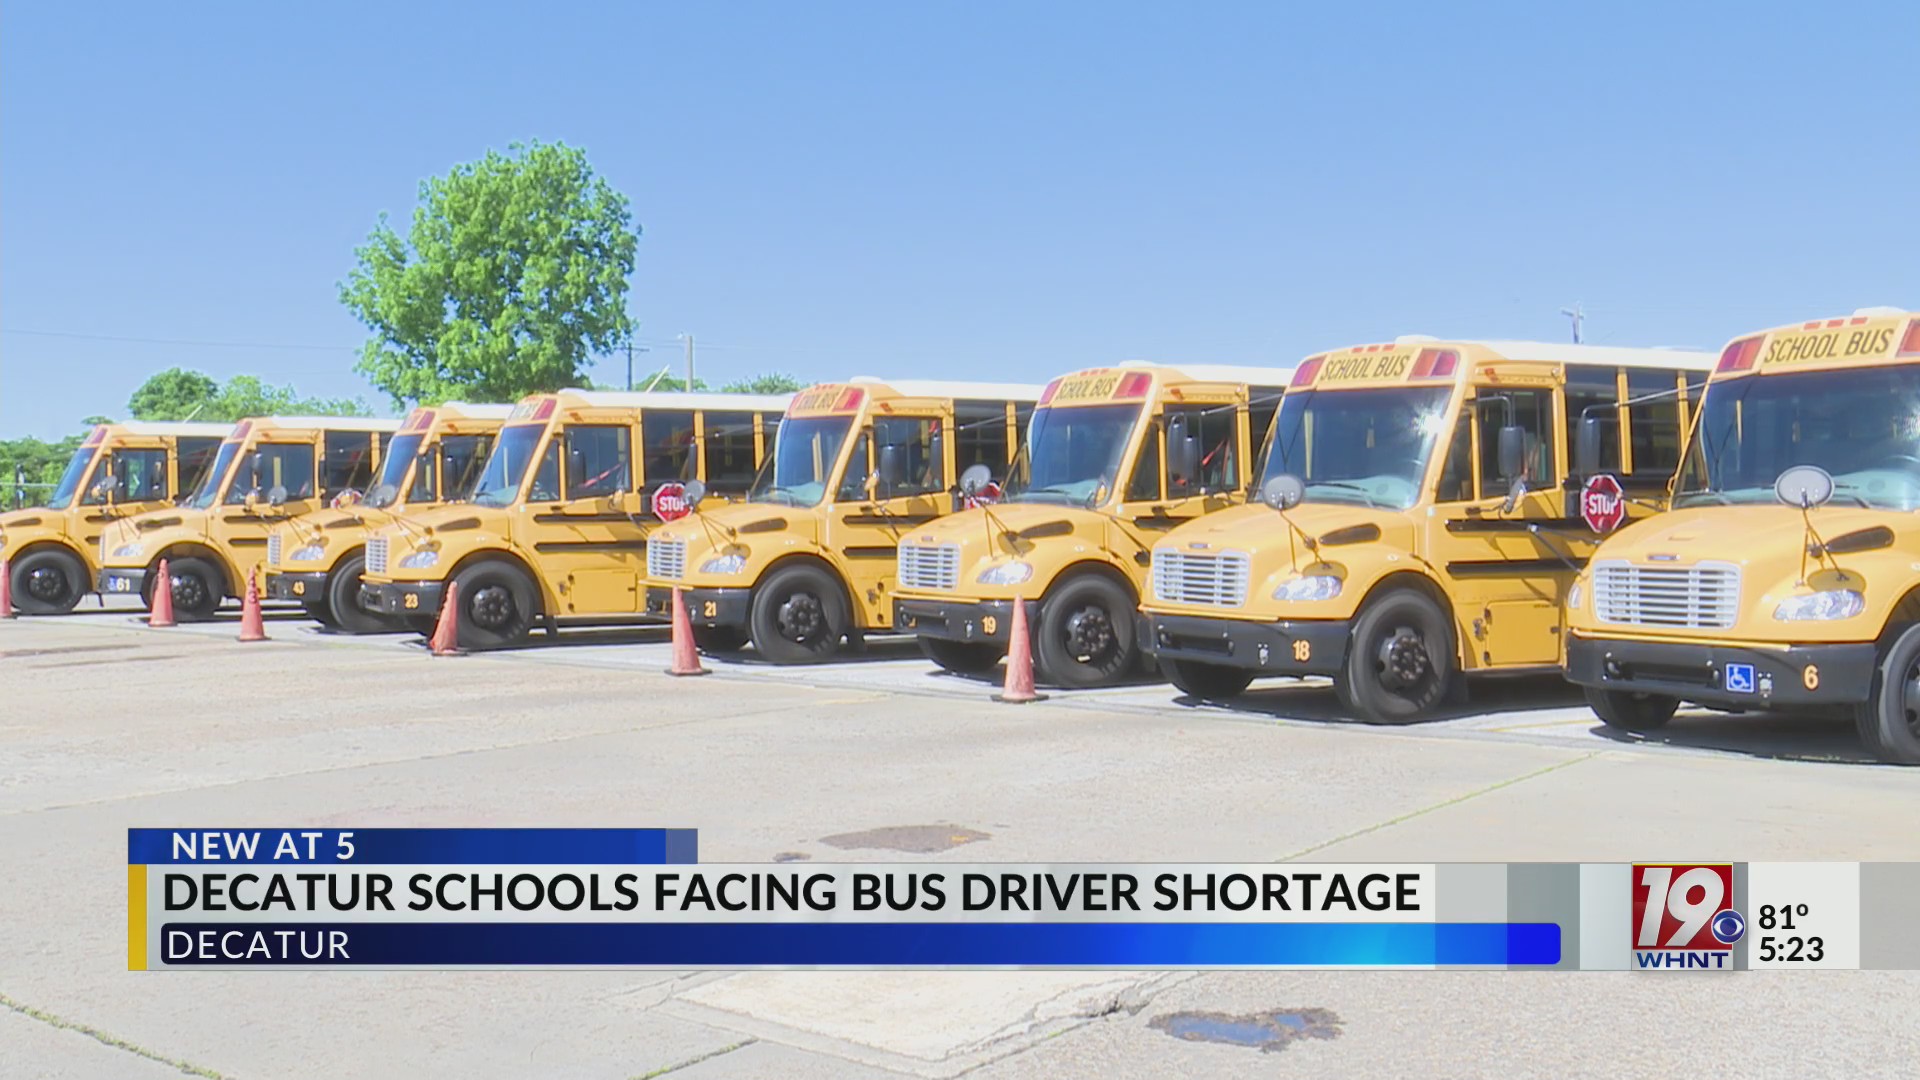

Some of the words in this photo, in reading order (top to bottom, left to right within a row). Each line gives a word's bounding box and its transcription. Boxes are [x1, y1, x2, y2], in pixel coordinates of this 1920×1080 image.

[1764, 333, 1839, 363] SCHOOL
[1844, 328, 1895, 356] BUS
[1320, 357, 1375, 381] SCHOOL
[1371, 355, 1411, 378] BUS
[1589, 493, 1619, 515] STOP
[116, 577, 130, 592] 61
[704, 600, 717, 617] 21
[981, 616, 997, 635] 19
[1292, 639, 1311, 662] 18
[1803, 664, 1819, 690] 6
